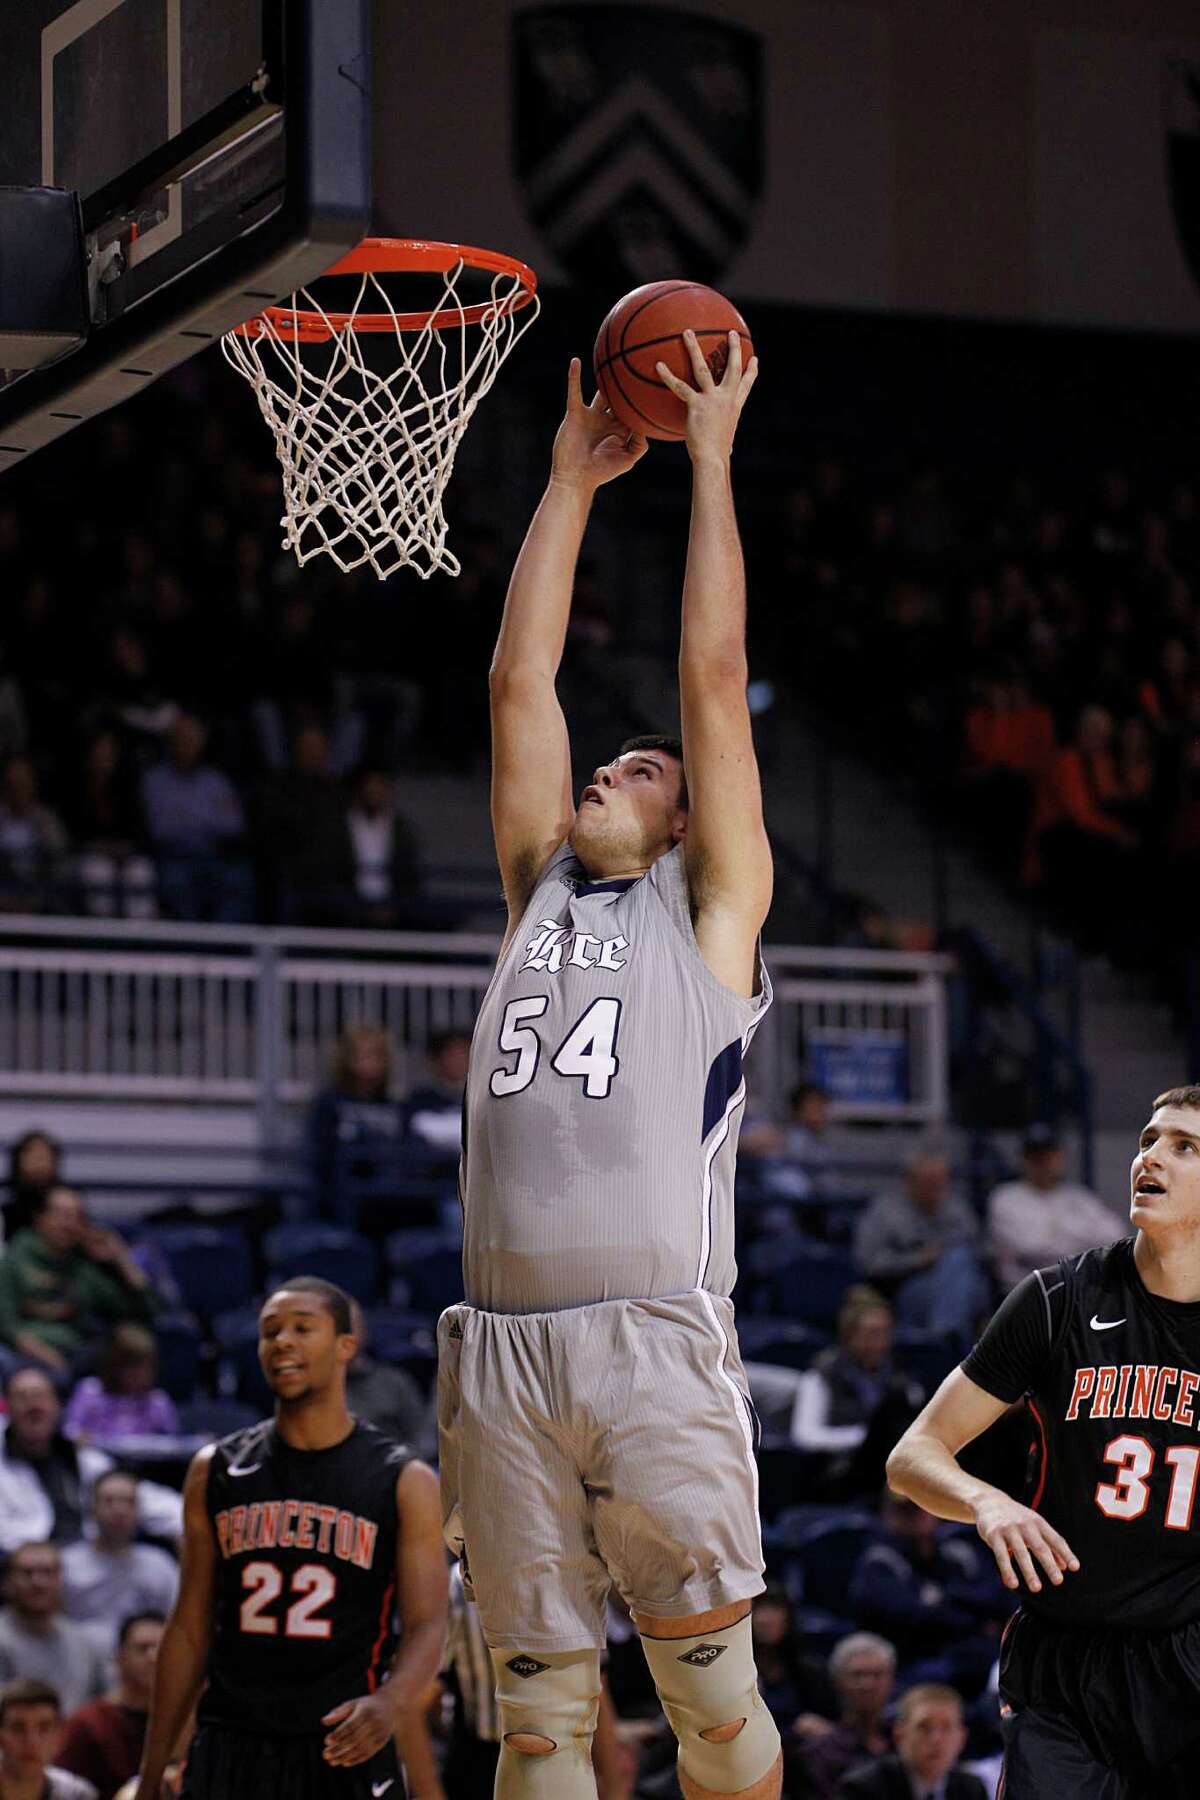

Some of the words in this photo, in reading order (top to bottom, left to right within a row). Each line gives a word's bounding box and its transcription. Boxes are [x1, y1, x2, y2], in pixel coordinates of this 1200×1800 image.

[518, 918, 630, 974] Rce
[489, 995, 622, 1099] 54
[1065, 1364, 1200, 1431] PRINCE
[1095, 1434, 1200, 1531] 31
[215, 1499, 379, 1570] PRINCETON
[239, 1561, 337, 1640] 22
[691, 1648, 718, 1661] PRO
